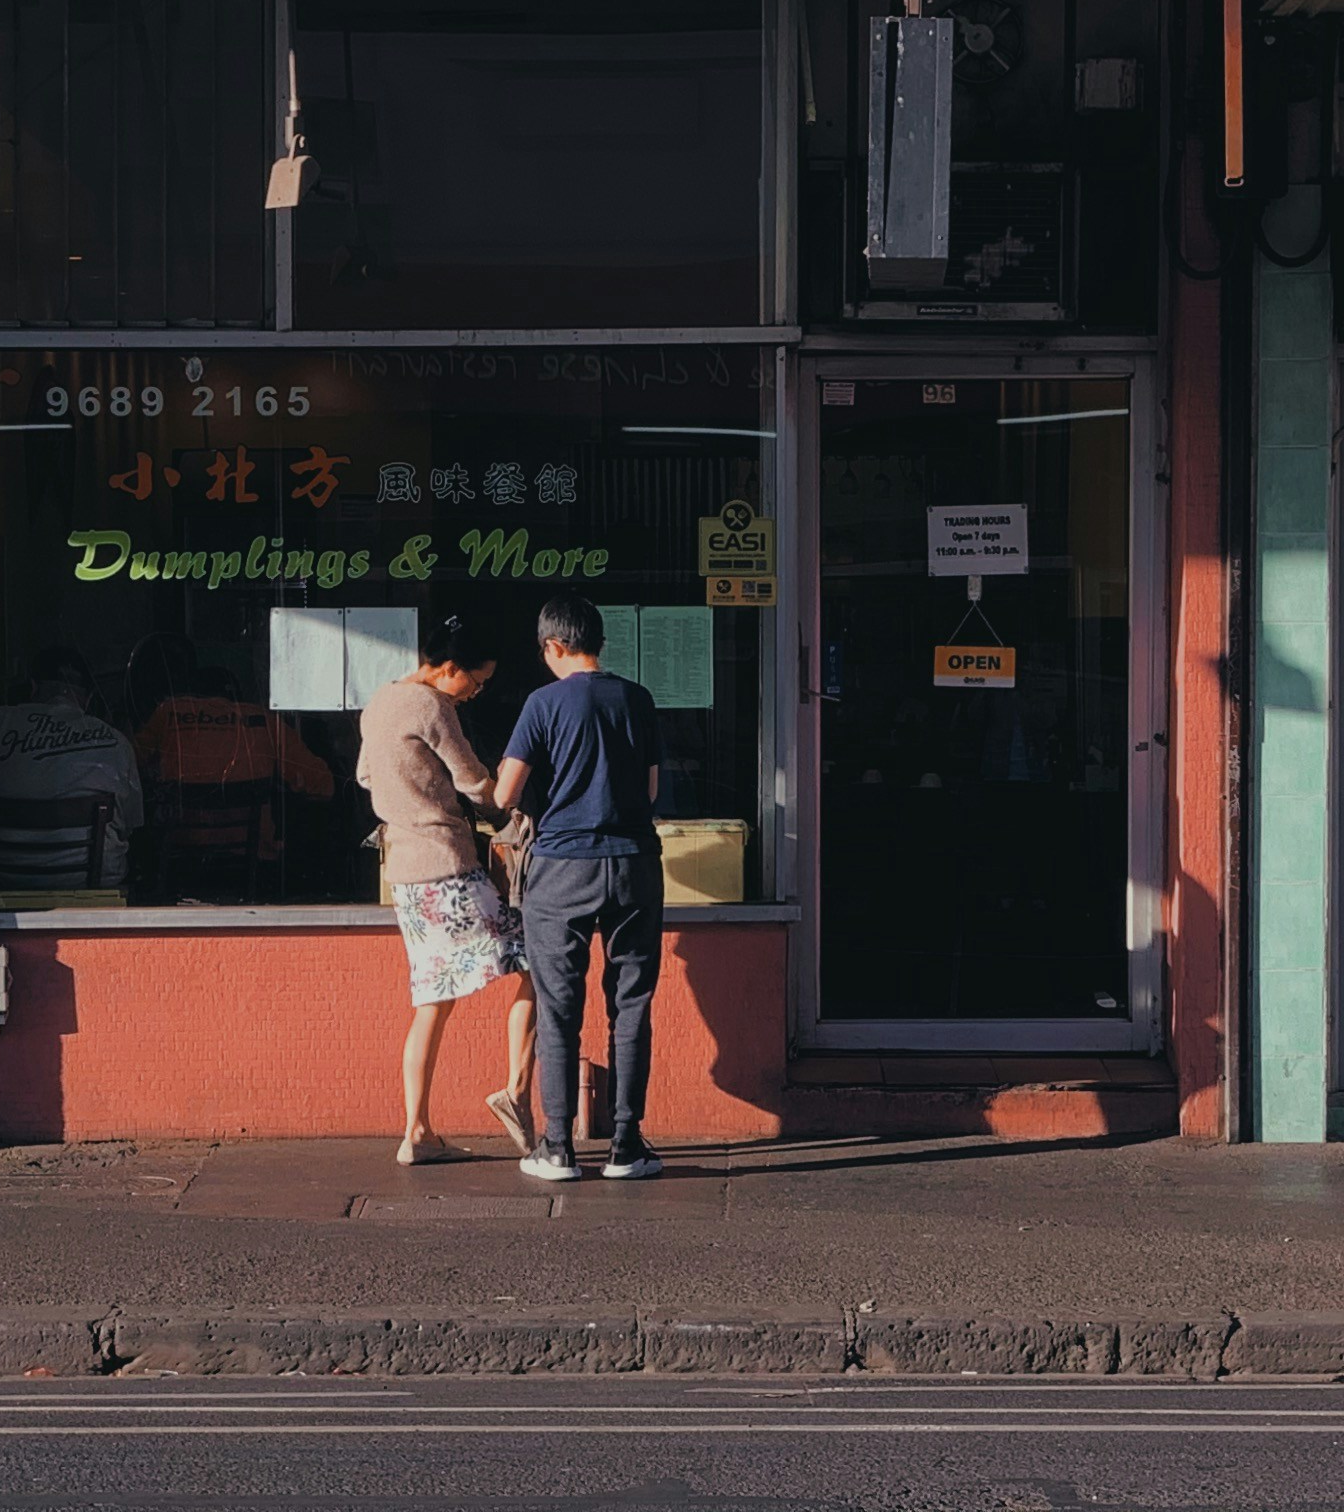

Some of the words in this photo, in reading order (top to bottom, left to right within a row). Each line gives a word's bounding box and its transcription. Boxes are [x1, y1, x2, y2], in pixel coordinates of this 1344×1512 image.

[46, 386, 165, 417] 9689
[192, 386, 312, 417] 2165
[924, 384, 954, 402] 96
[944, 516, 980, 526] TRADING
[982, 515, 1011, 525] HOURS
[709, 533, 765, 551] EASI
[952, 532, 973, 542] Open
[975, 531, 980, 540] 7
[982, 531, 1001, 542] days
[67, 529, 370, 590] Dumplings
[389, 535, 439, 580] &
[459, 528, 609, 580] More
[936, 547, 957, 556] 11:00
[948, 655, 1001, 670] OPEN
[27, 712, 68, 735] The
[0, 728, 117, 761] Hundreds
